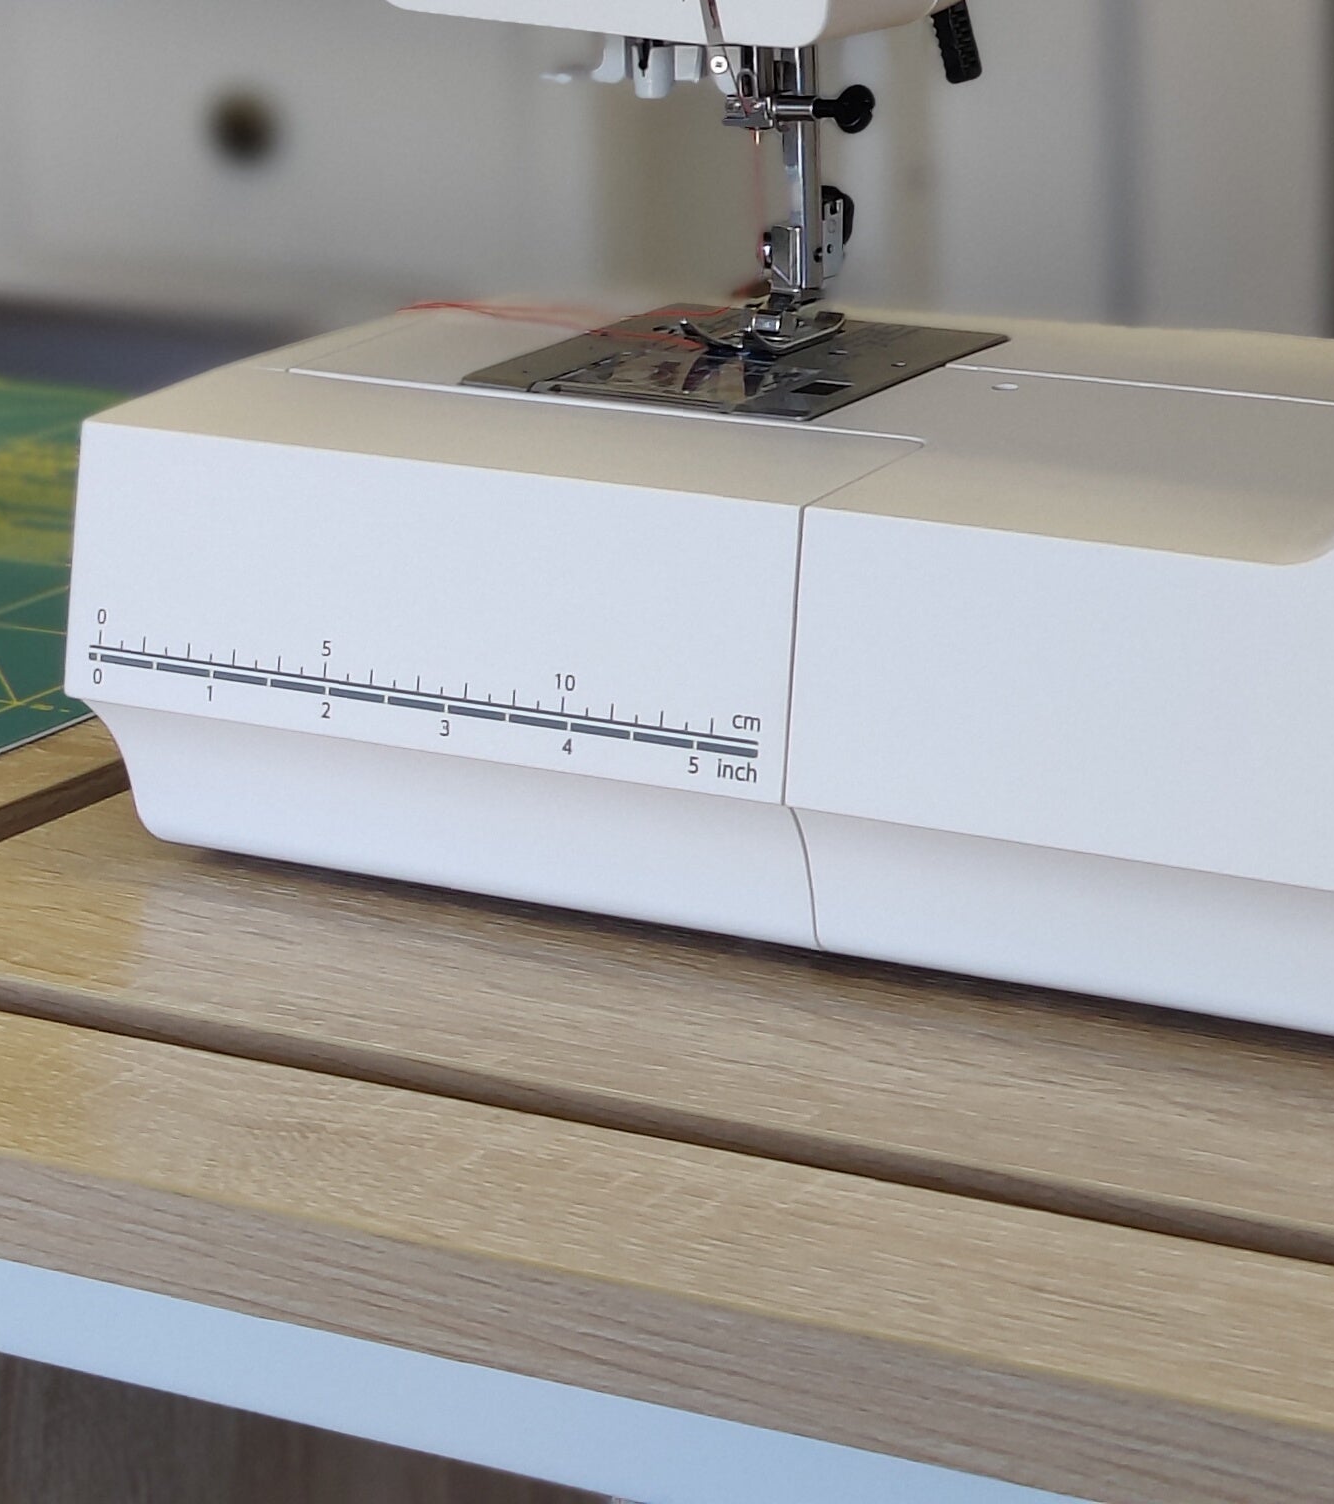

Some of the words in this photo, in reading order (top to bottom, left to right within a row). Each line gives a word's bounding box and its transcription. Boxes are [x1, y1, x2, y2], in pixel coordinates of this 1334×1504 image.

[92, 668, 103, 685] 0
[321, 701, 331, 719] 2
[439, 719, 450, 737] 3
[562, 738, 572, 755] 4
[688, 756, 699, 774] 5
[717, 756, 757, 783] inch
[97, 608, 107, 625] 0
[321, 640, 331, 657] 5
[555, 673, 576, 692] 10
[732, 712, 761, 733] cm
